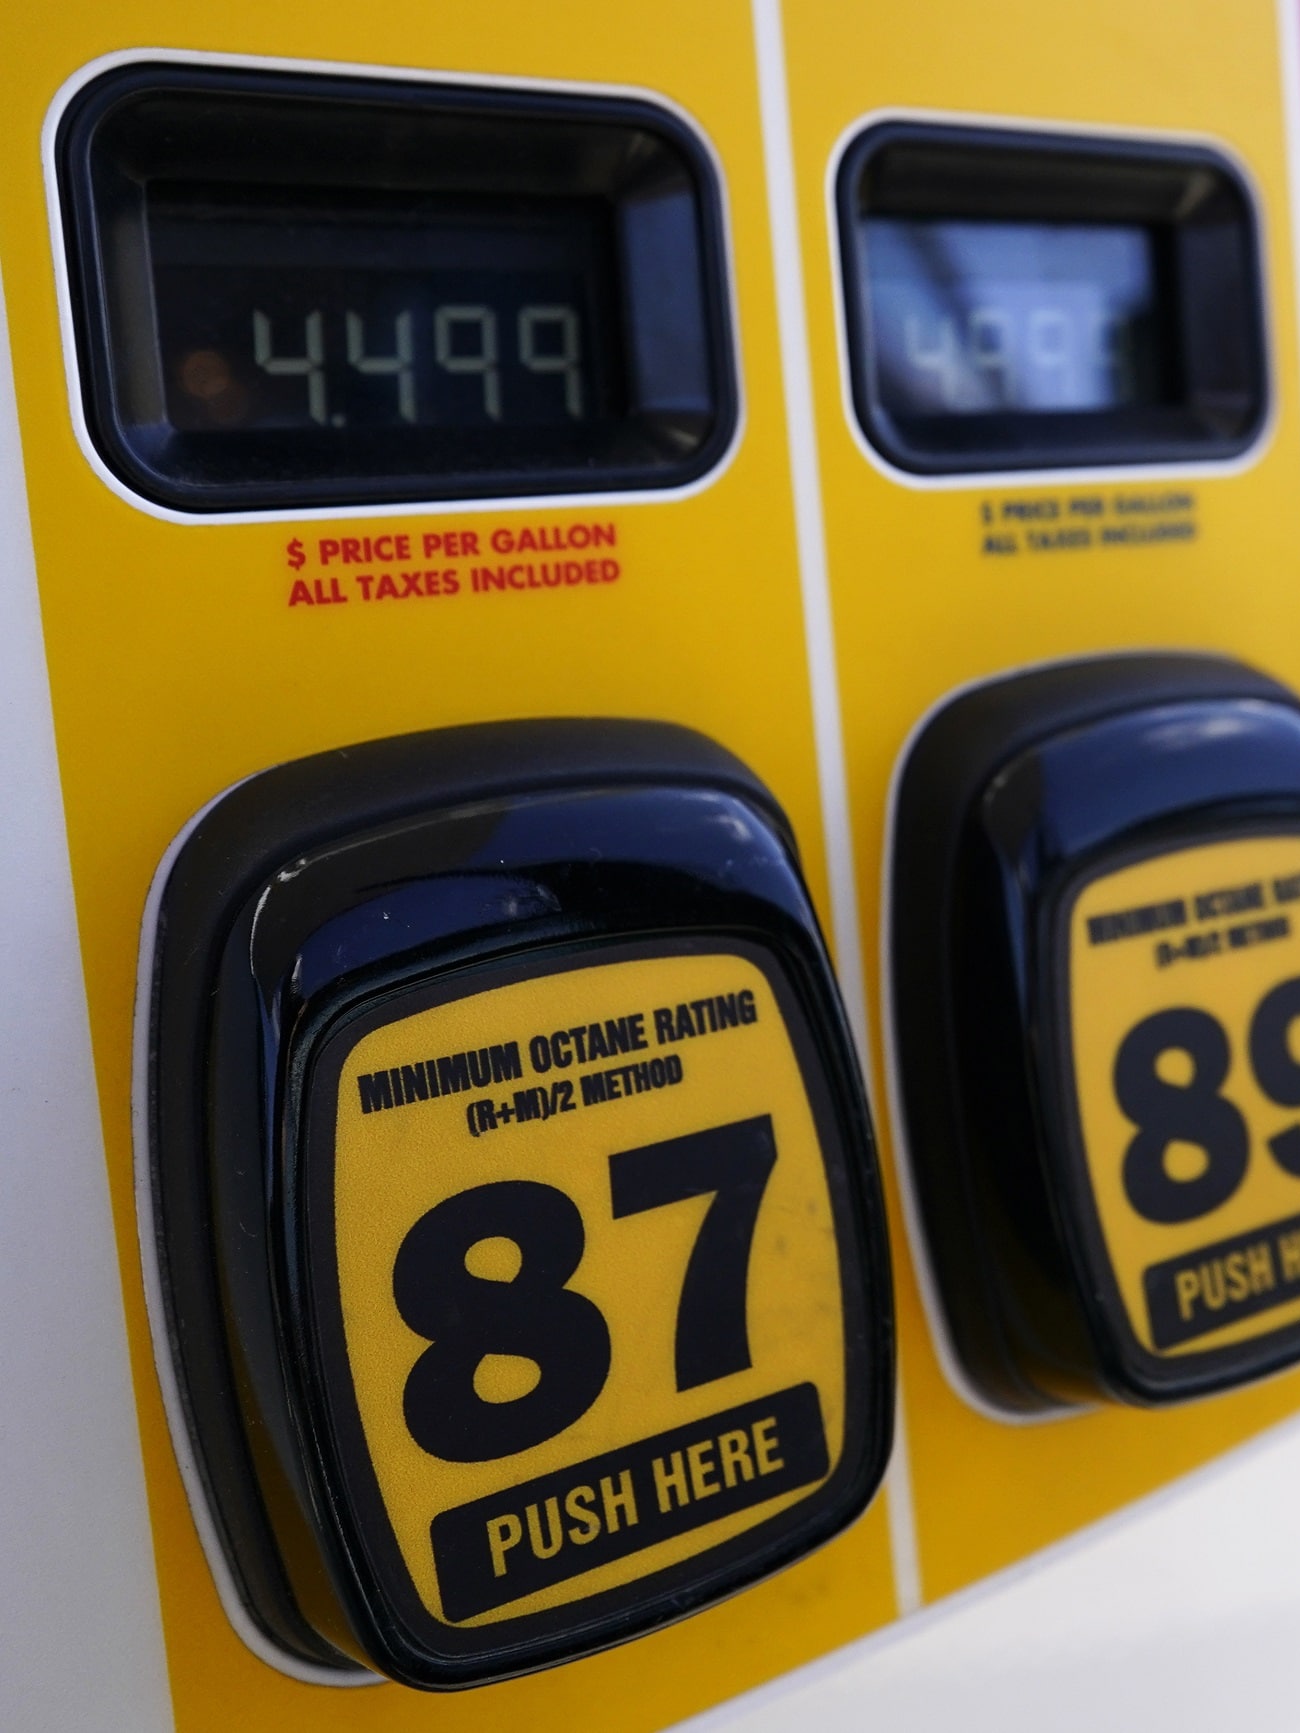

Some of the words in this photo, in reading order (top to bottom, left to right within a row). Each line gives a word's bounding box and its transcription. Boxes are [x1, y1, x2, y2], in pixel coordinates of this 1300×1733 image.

[253, 306, 583, 427] 4.499
[286, 538, 306, 571] $
[318, 533, 411, 566] PRICE
[422, 531, 480, 560] PER
[490, 522, 616, 555] GALLON
[288, 578, 348, 607] ALL
[356, 568, 460, 601] TAXES
[470, 558, 620, 593] INCLUDED
[357, 1040, 523, 1114] MINIMUM
[528, 1013, 649, 1074] OCTANE
[653, 989, 758, 1045] RATING
[466, 1080, 577, 1138] (R+M)/2
[579, 1054, 683, 1107] METHOD
[392, 1113, 778, 1463] 87
[1174, 1241, 1276, 1321] PUSH
[486, 1469, 639, 1578] PUSH
[651, 1416, 785, 1514] HERE
